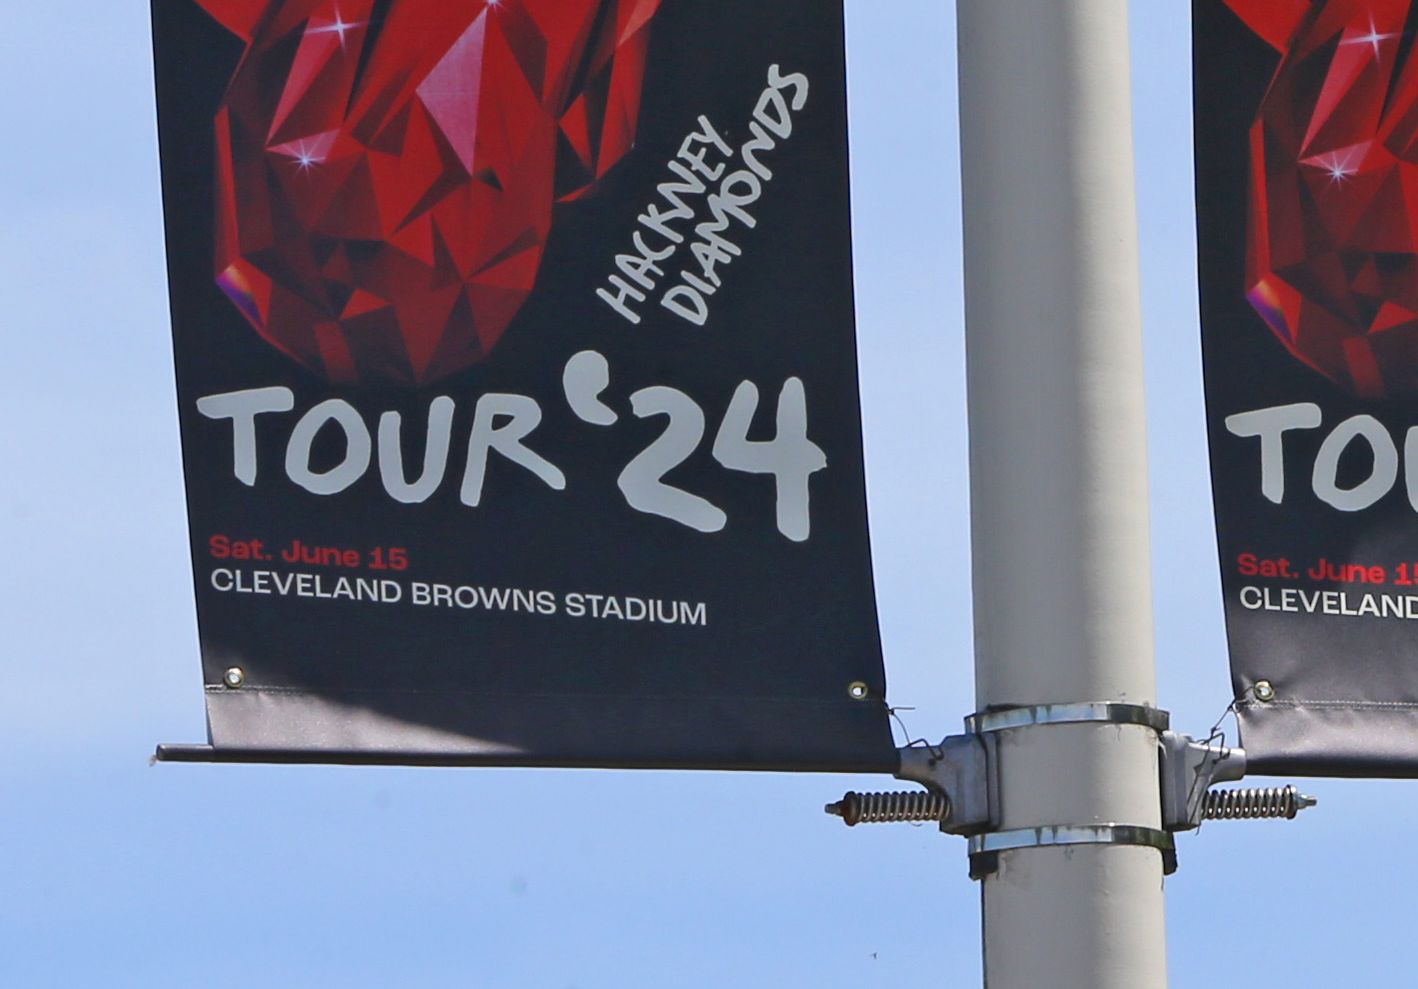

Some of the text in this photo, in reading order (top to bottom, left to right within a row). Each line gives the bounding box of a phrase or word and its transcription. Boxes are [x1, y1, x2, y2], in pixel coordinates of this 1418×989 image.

[596, 114, 734, 325] HACKNEY
[660, 63, 809, 326] DIAMONDS
[196, 349, 828, 542] TOUR '24
[209, 534, 409, 570] Sat. June 15
[211, 568, 708, 626] CLEVELAND BROWNS STADIUM
[1237, 553, 1299, 578] Sat.
[1308, 558, 1387, 584] June
